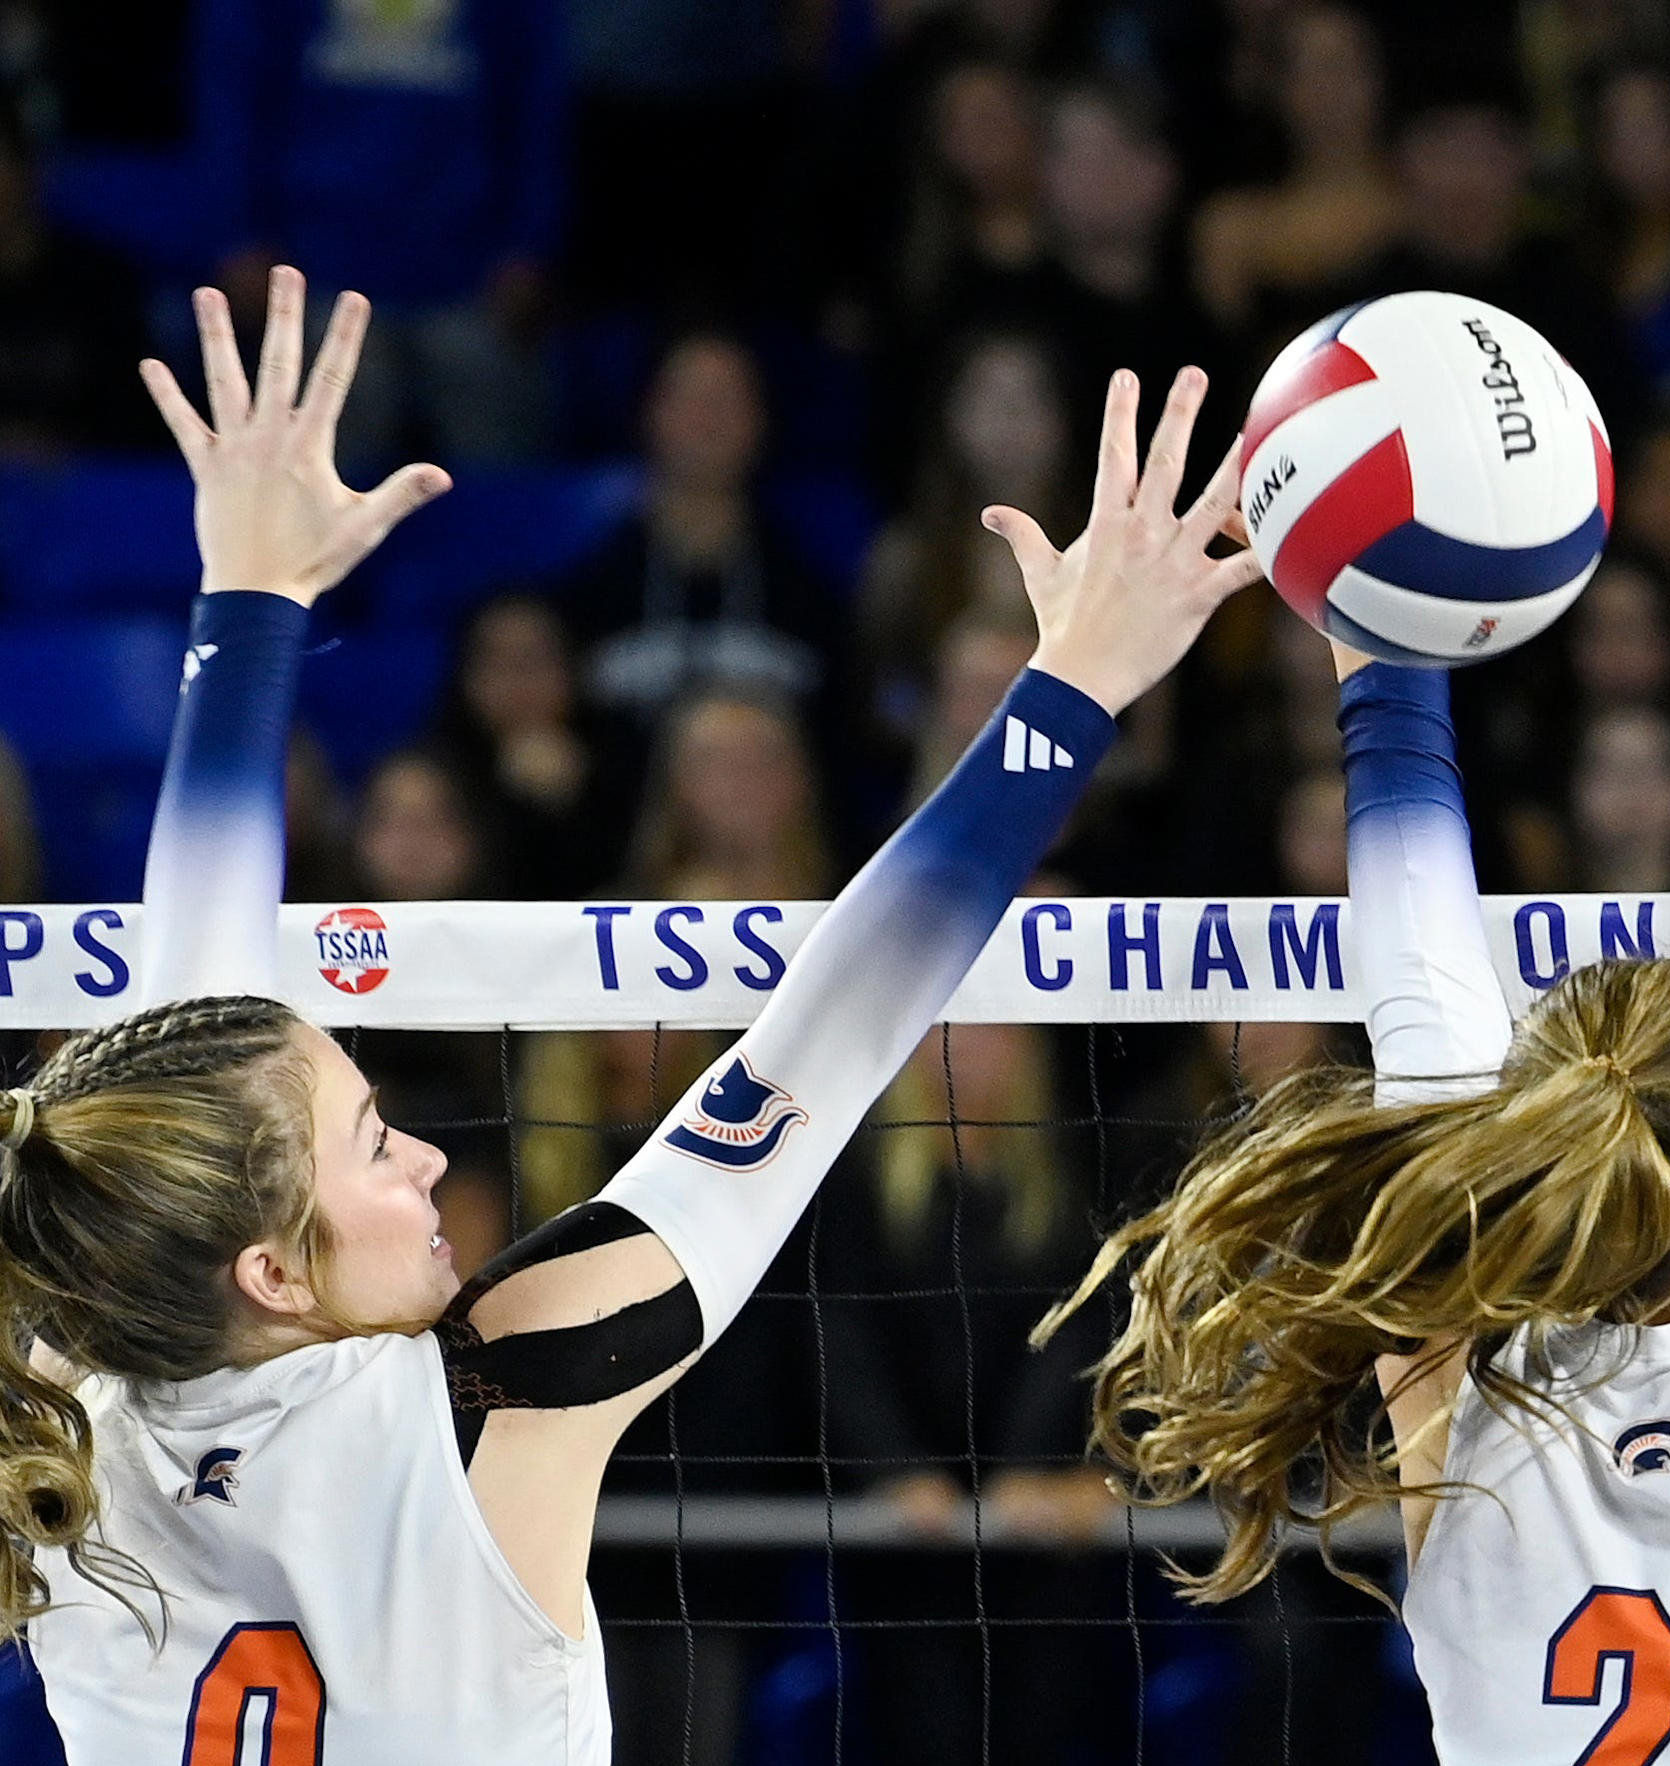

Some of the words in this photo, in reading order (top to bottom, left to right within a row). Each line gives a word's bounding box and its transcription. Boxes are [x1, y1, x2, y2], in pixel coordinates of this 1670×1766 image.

[1462, 317, 1537, 462] Wilson
[314, 928, 389, 961] TSSAA
[581, 905, 787, 991] TSS
